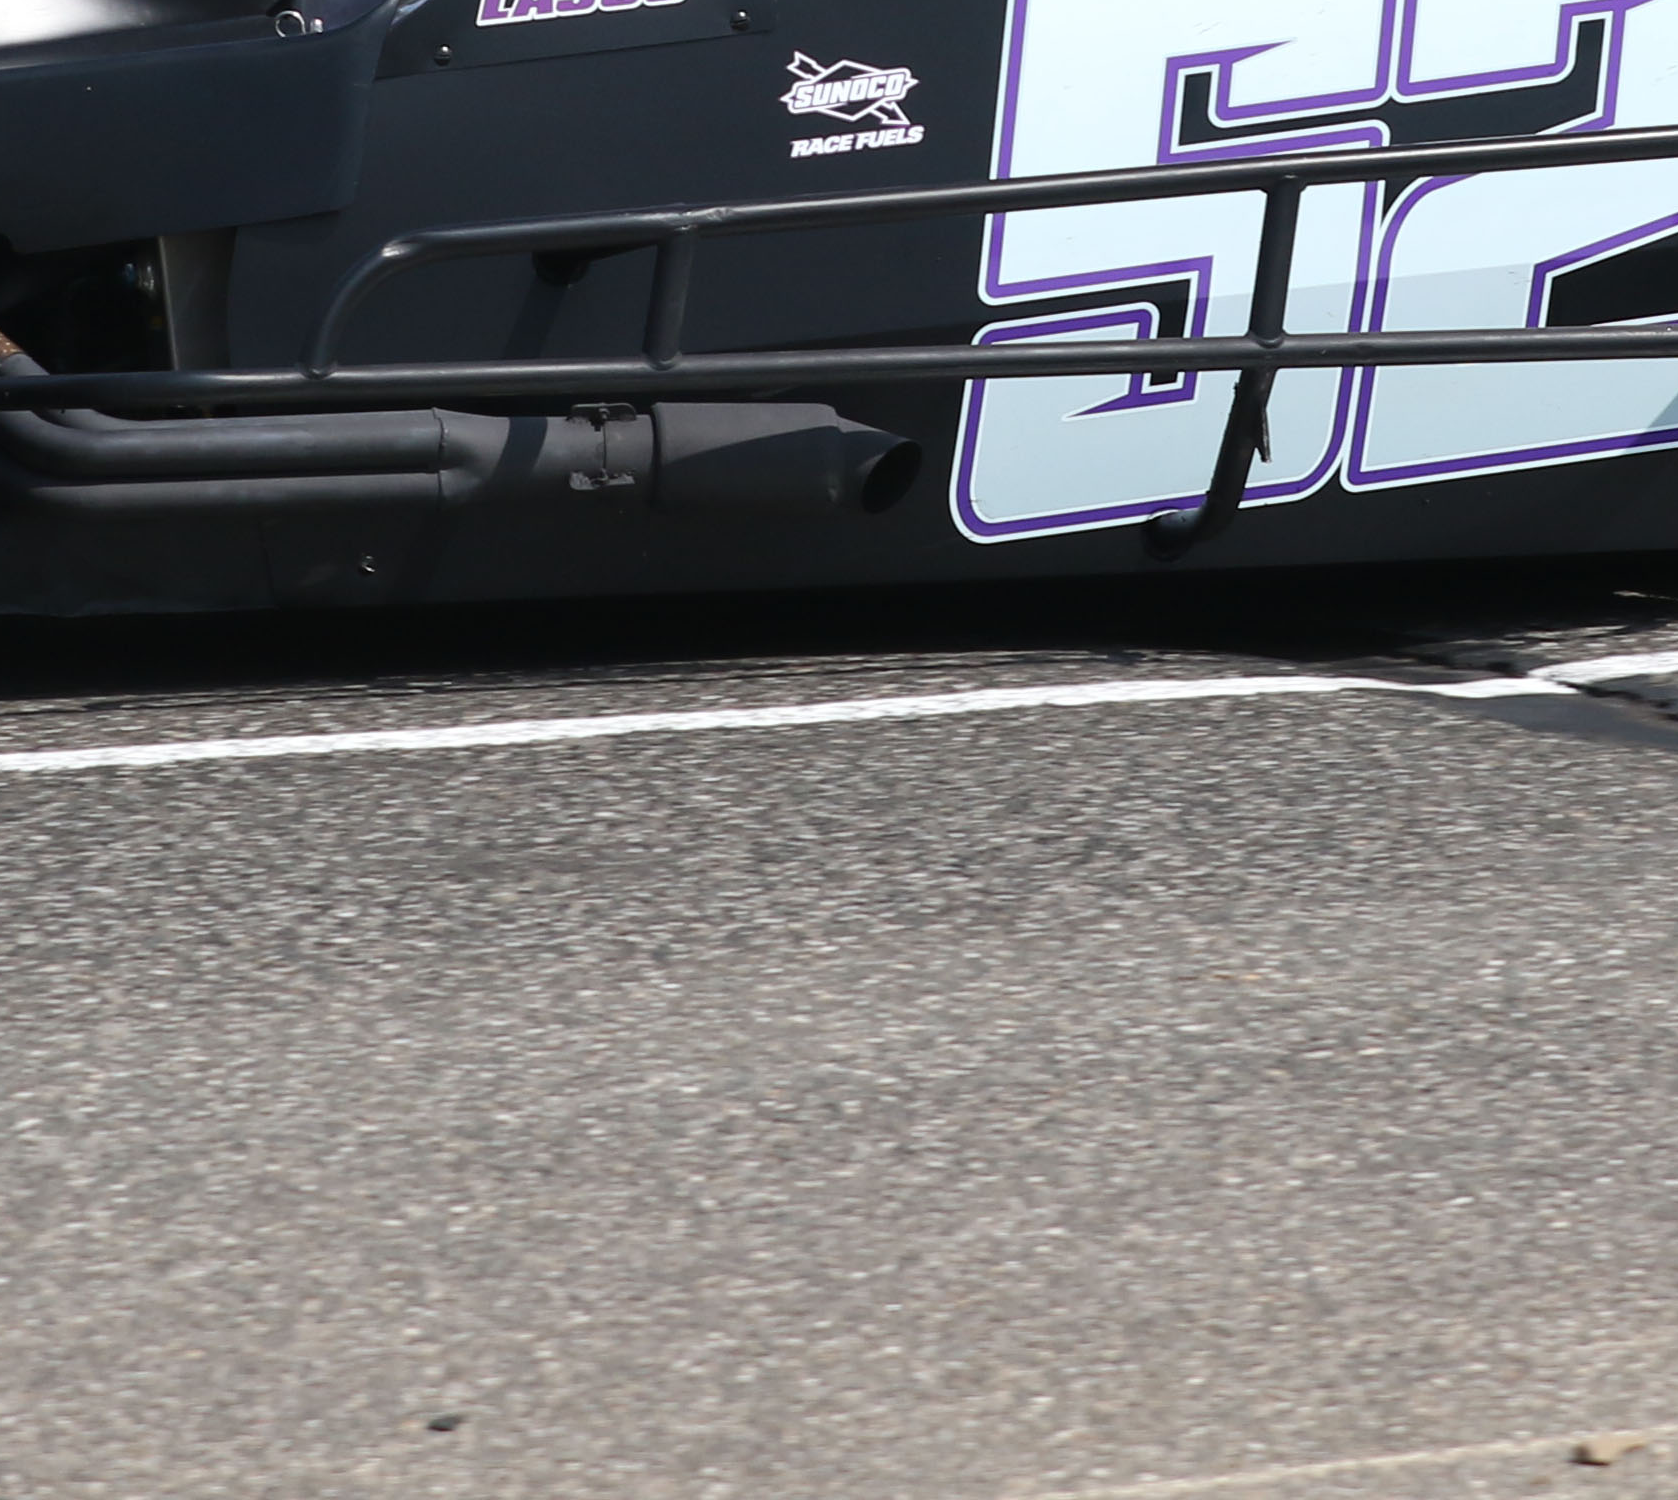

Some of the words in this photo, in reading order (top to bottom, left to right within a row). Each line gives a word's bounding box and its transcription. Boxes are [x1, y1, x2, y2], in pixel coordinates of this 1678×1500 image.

[793, 72, 906, 109] SUNOCO
[790, 133, 854, 157] RACE
[854, 125, 925, 150] FUELS
